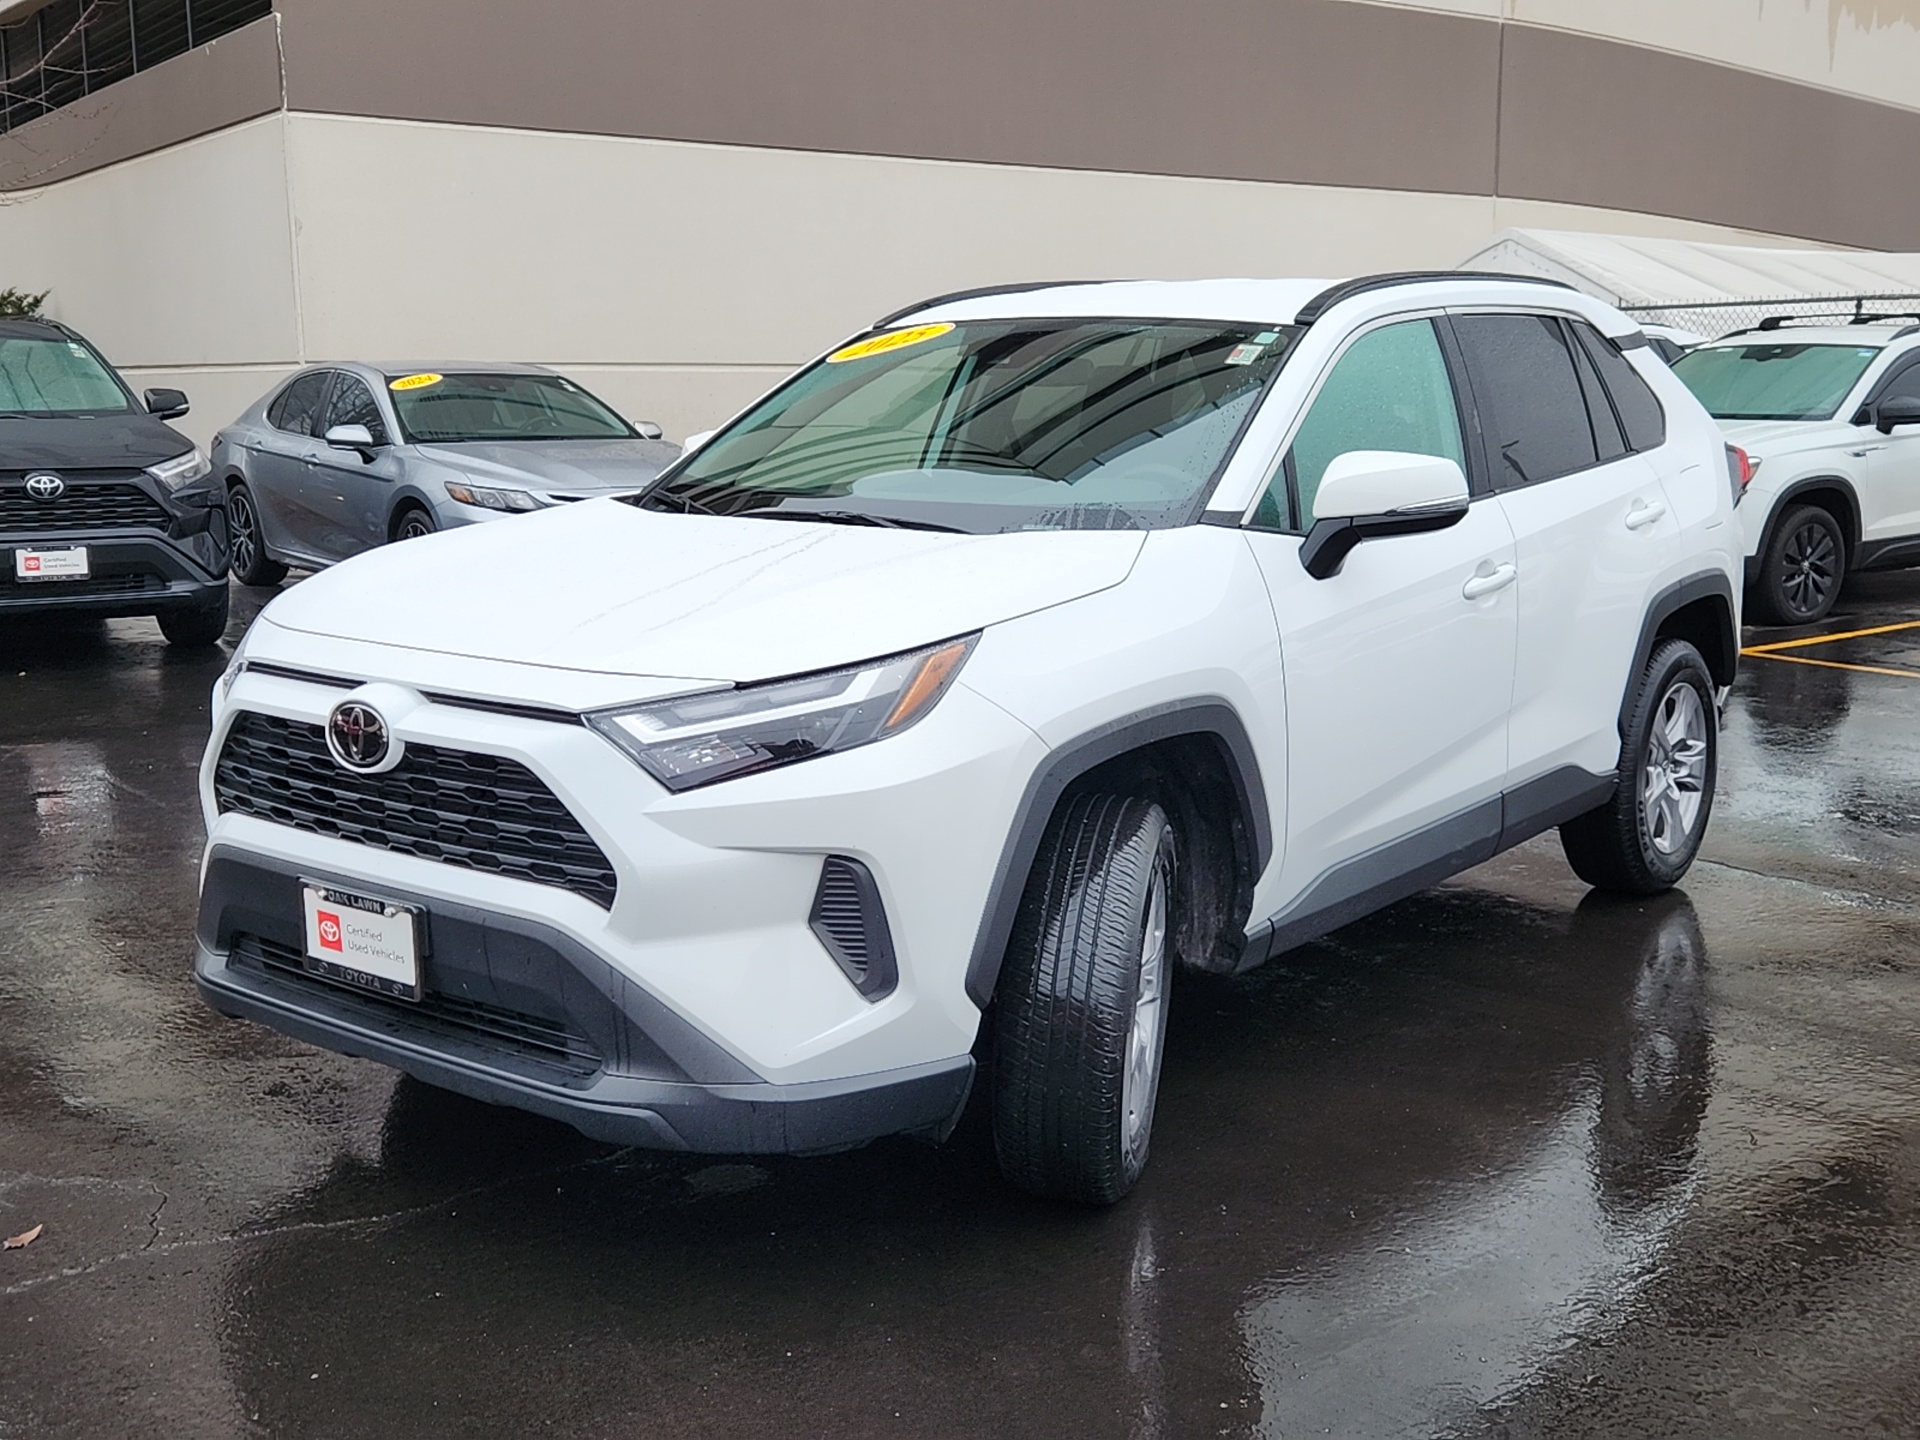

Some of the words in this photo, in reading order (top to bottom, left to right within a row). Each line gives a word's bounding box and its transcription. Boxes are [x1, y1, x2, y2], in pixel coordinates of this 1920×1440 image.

[398, 375, 433, 388] 2024
[328, 890, 350, 908] OAK
[351, 896, 381, 913] LAWN
[346, 923, 382, 942] Certified
[347, 939, 368, 954] Used
[369, 945, 405, 964] Vehicles
[339, 966, 381, 989] TOYOTA
